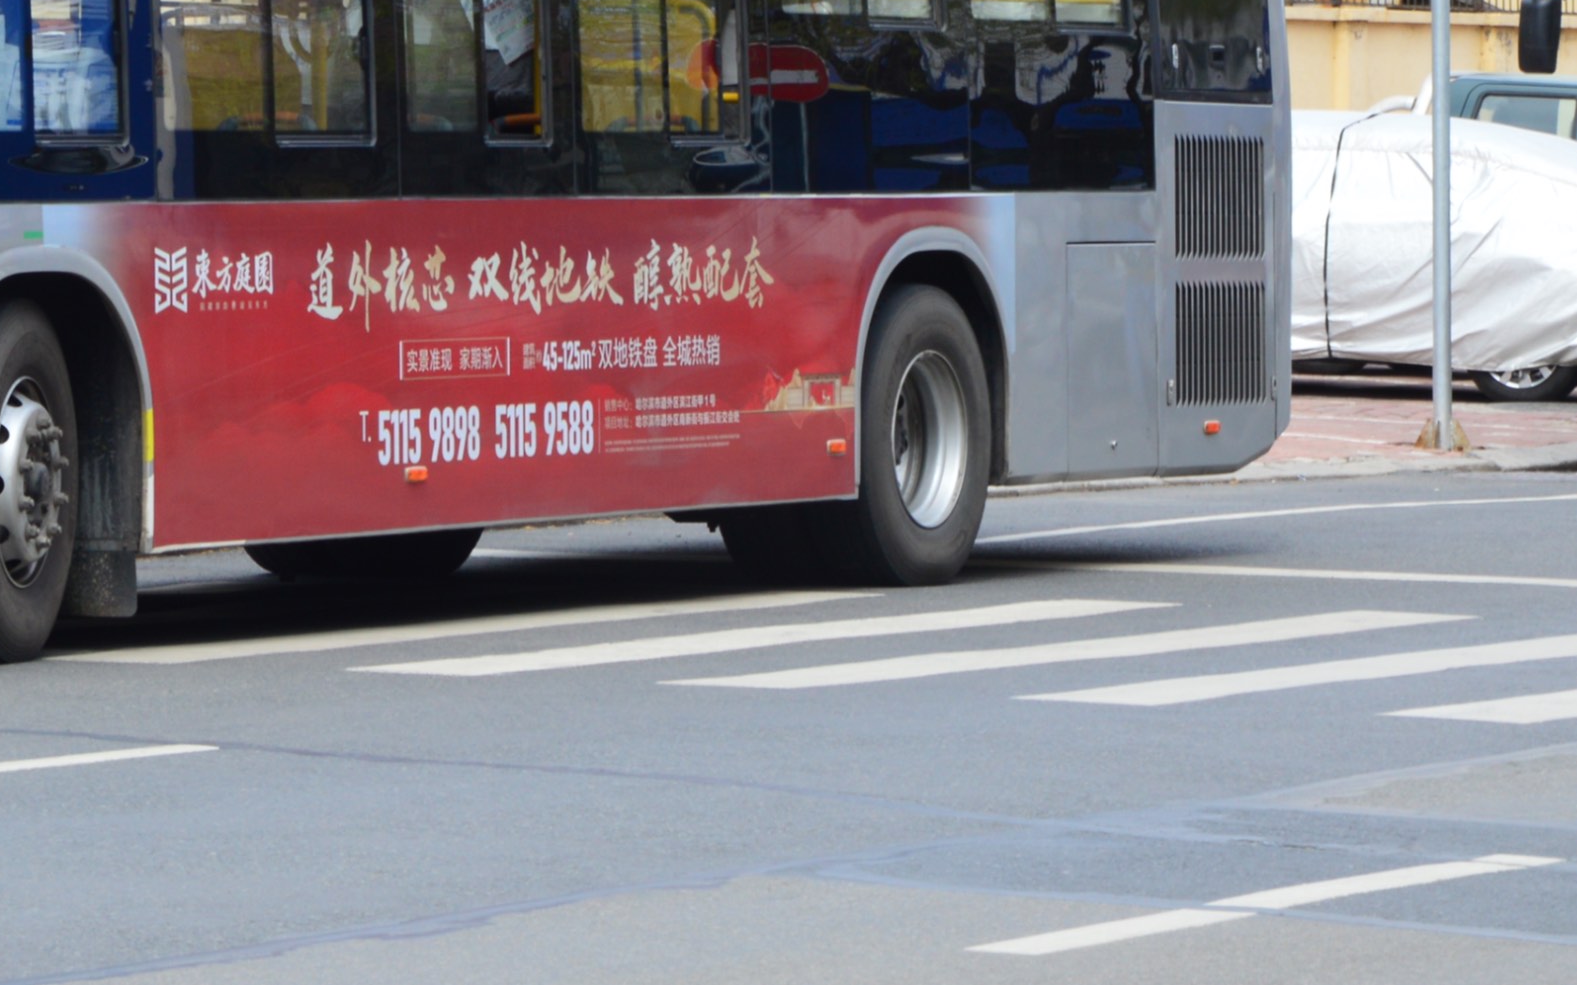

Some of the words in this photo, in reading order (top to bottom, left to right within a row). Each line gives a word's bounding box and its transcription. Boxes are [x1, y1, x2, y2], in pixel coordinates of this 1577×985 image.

[307, 239, 455, 333] 道外核芯
[468, 241, 624, 315] 双线地铁
[633, 236, 774, 311] 醇熟配套
[407, 348, 452, 372] 实景准现
[662, 335, 720, 366] 全城热销
[378, 408, 422, 466] 5115
[428, 405, 480, 463] 9898
[495, 403, 536, 459] 5115
[544, 400, 594, 456] 9588
